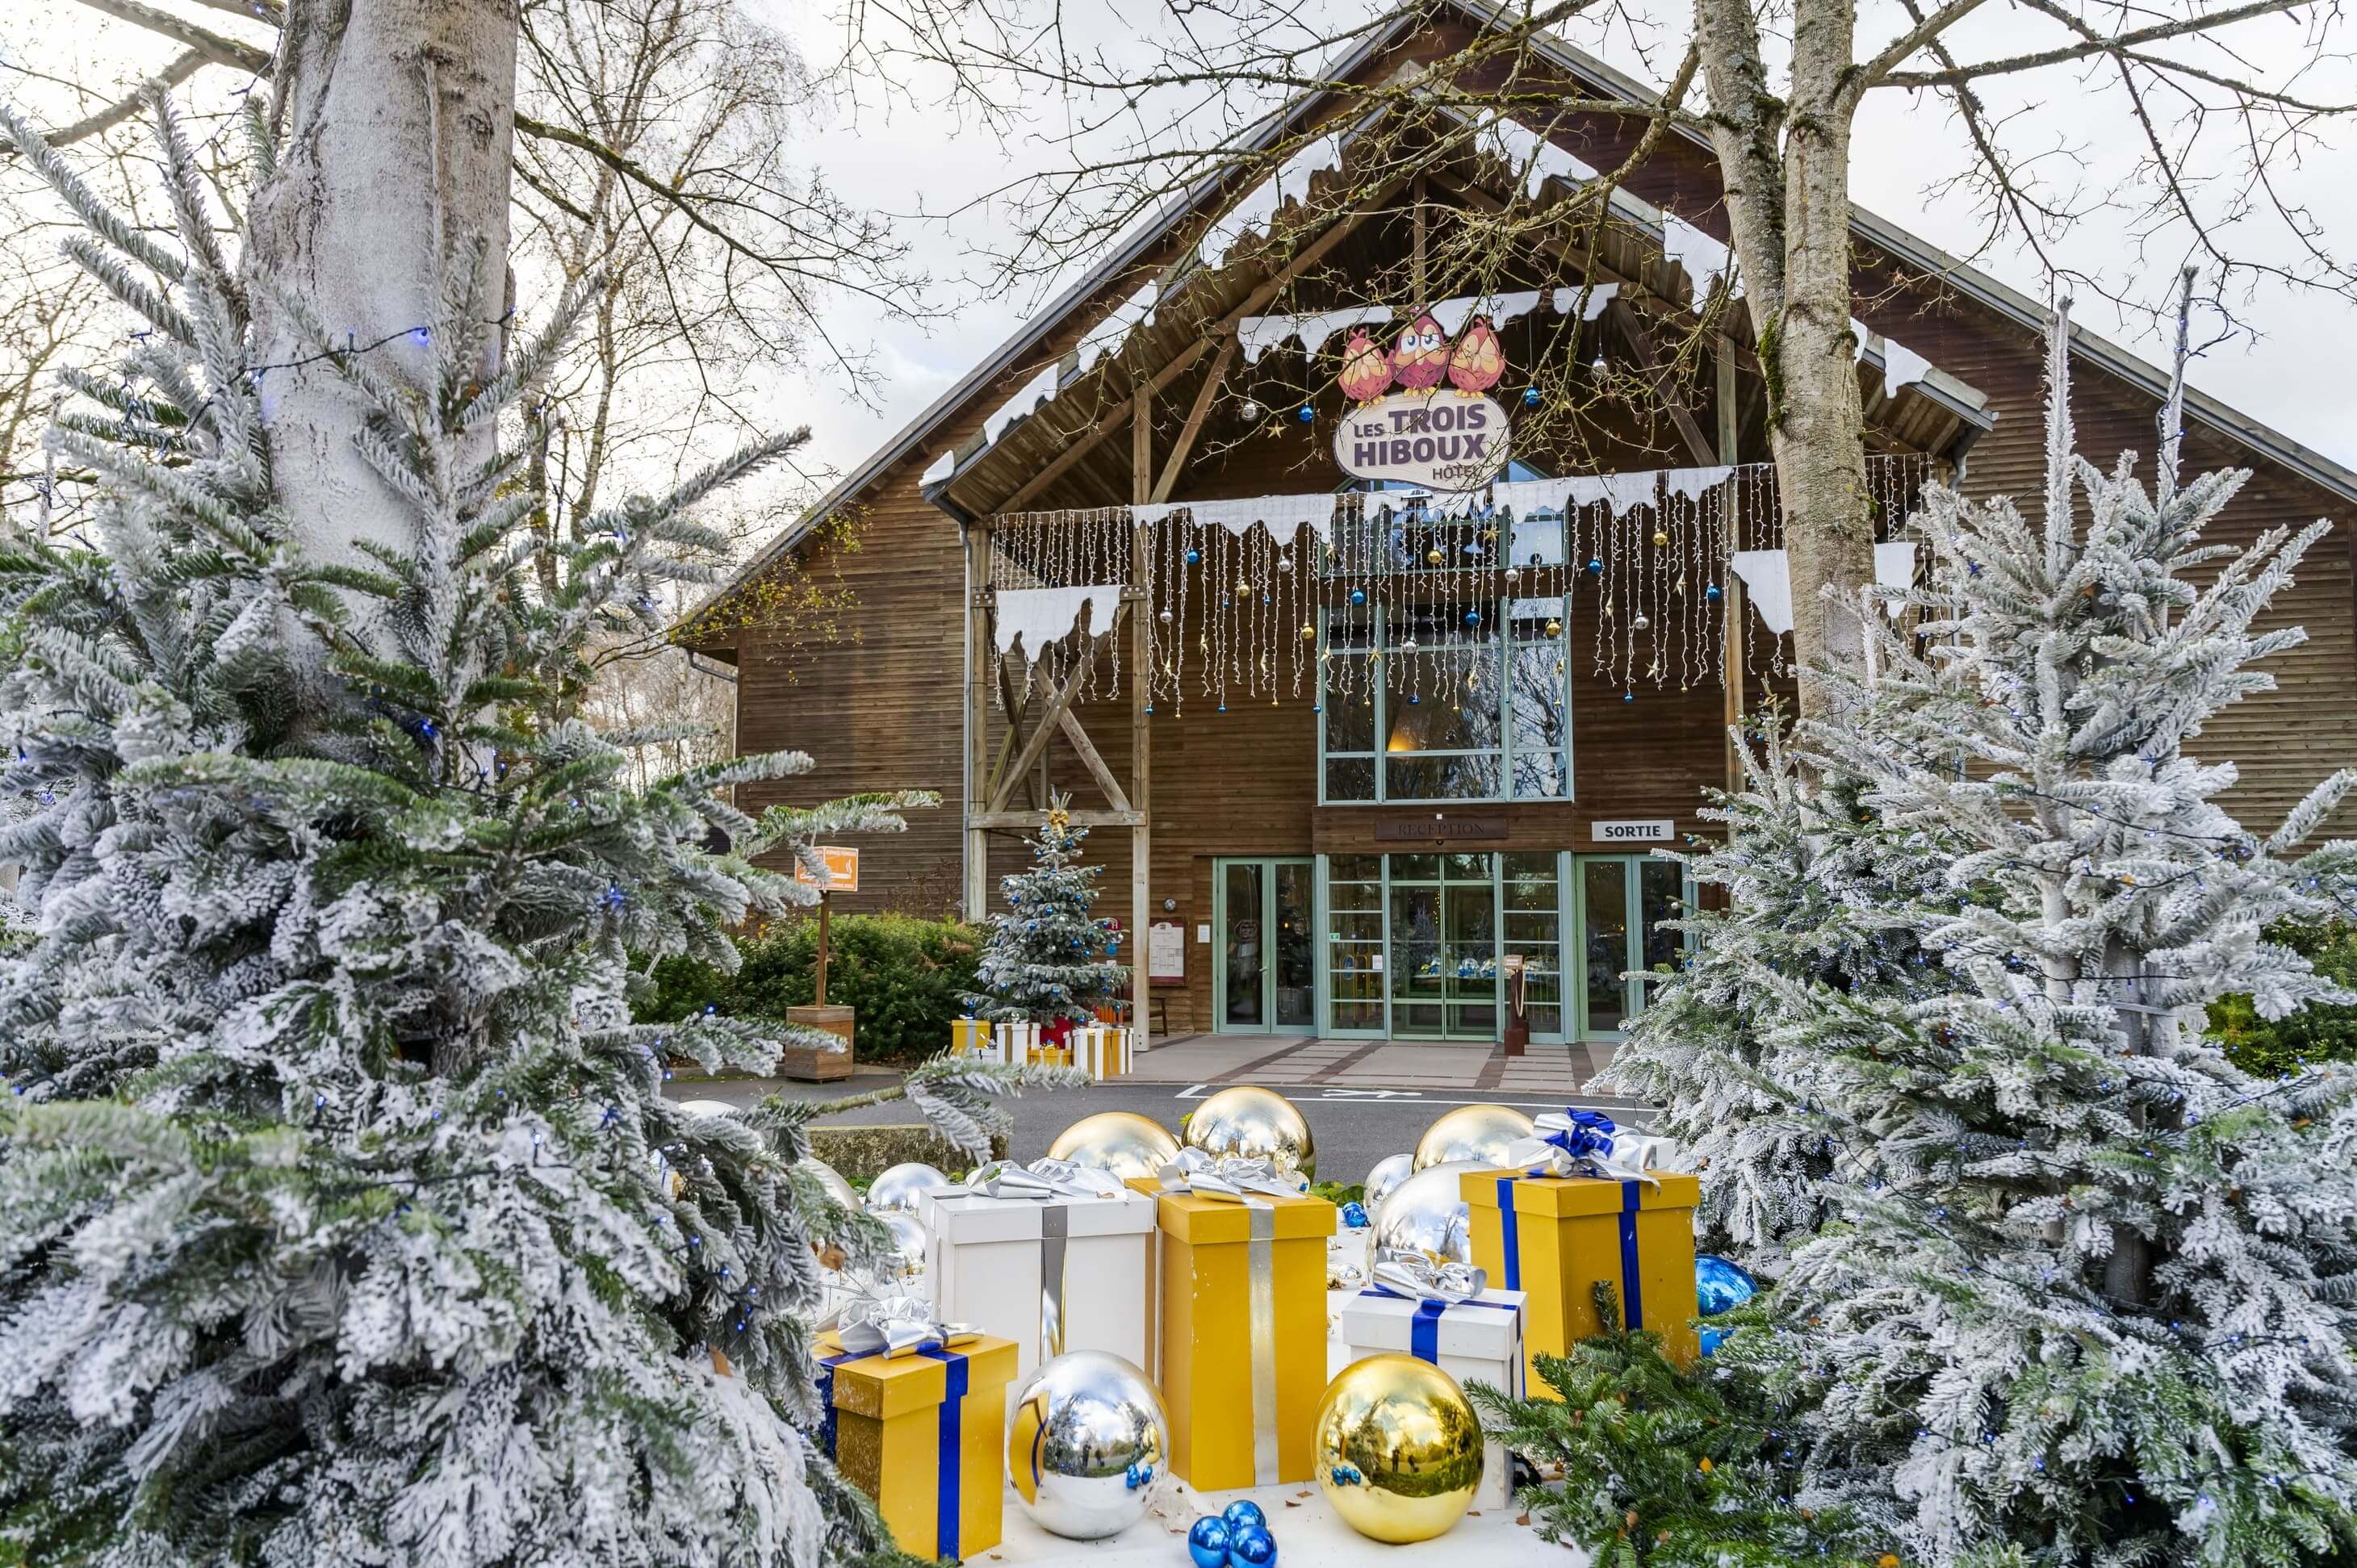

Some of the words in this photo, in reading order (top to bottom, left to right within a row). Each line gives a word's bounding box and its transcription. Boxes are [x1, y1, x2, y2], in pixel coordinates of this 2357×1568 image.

[1354, 423, 1385, 438] LES
[1388, 403, 1486, 435] TROIS
[1354, 433, 1486, 467] HIBOUX
[1397, 823, 1484, 835] RECEPTION
[1605, 825, 1661, 838] SORTIE
